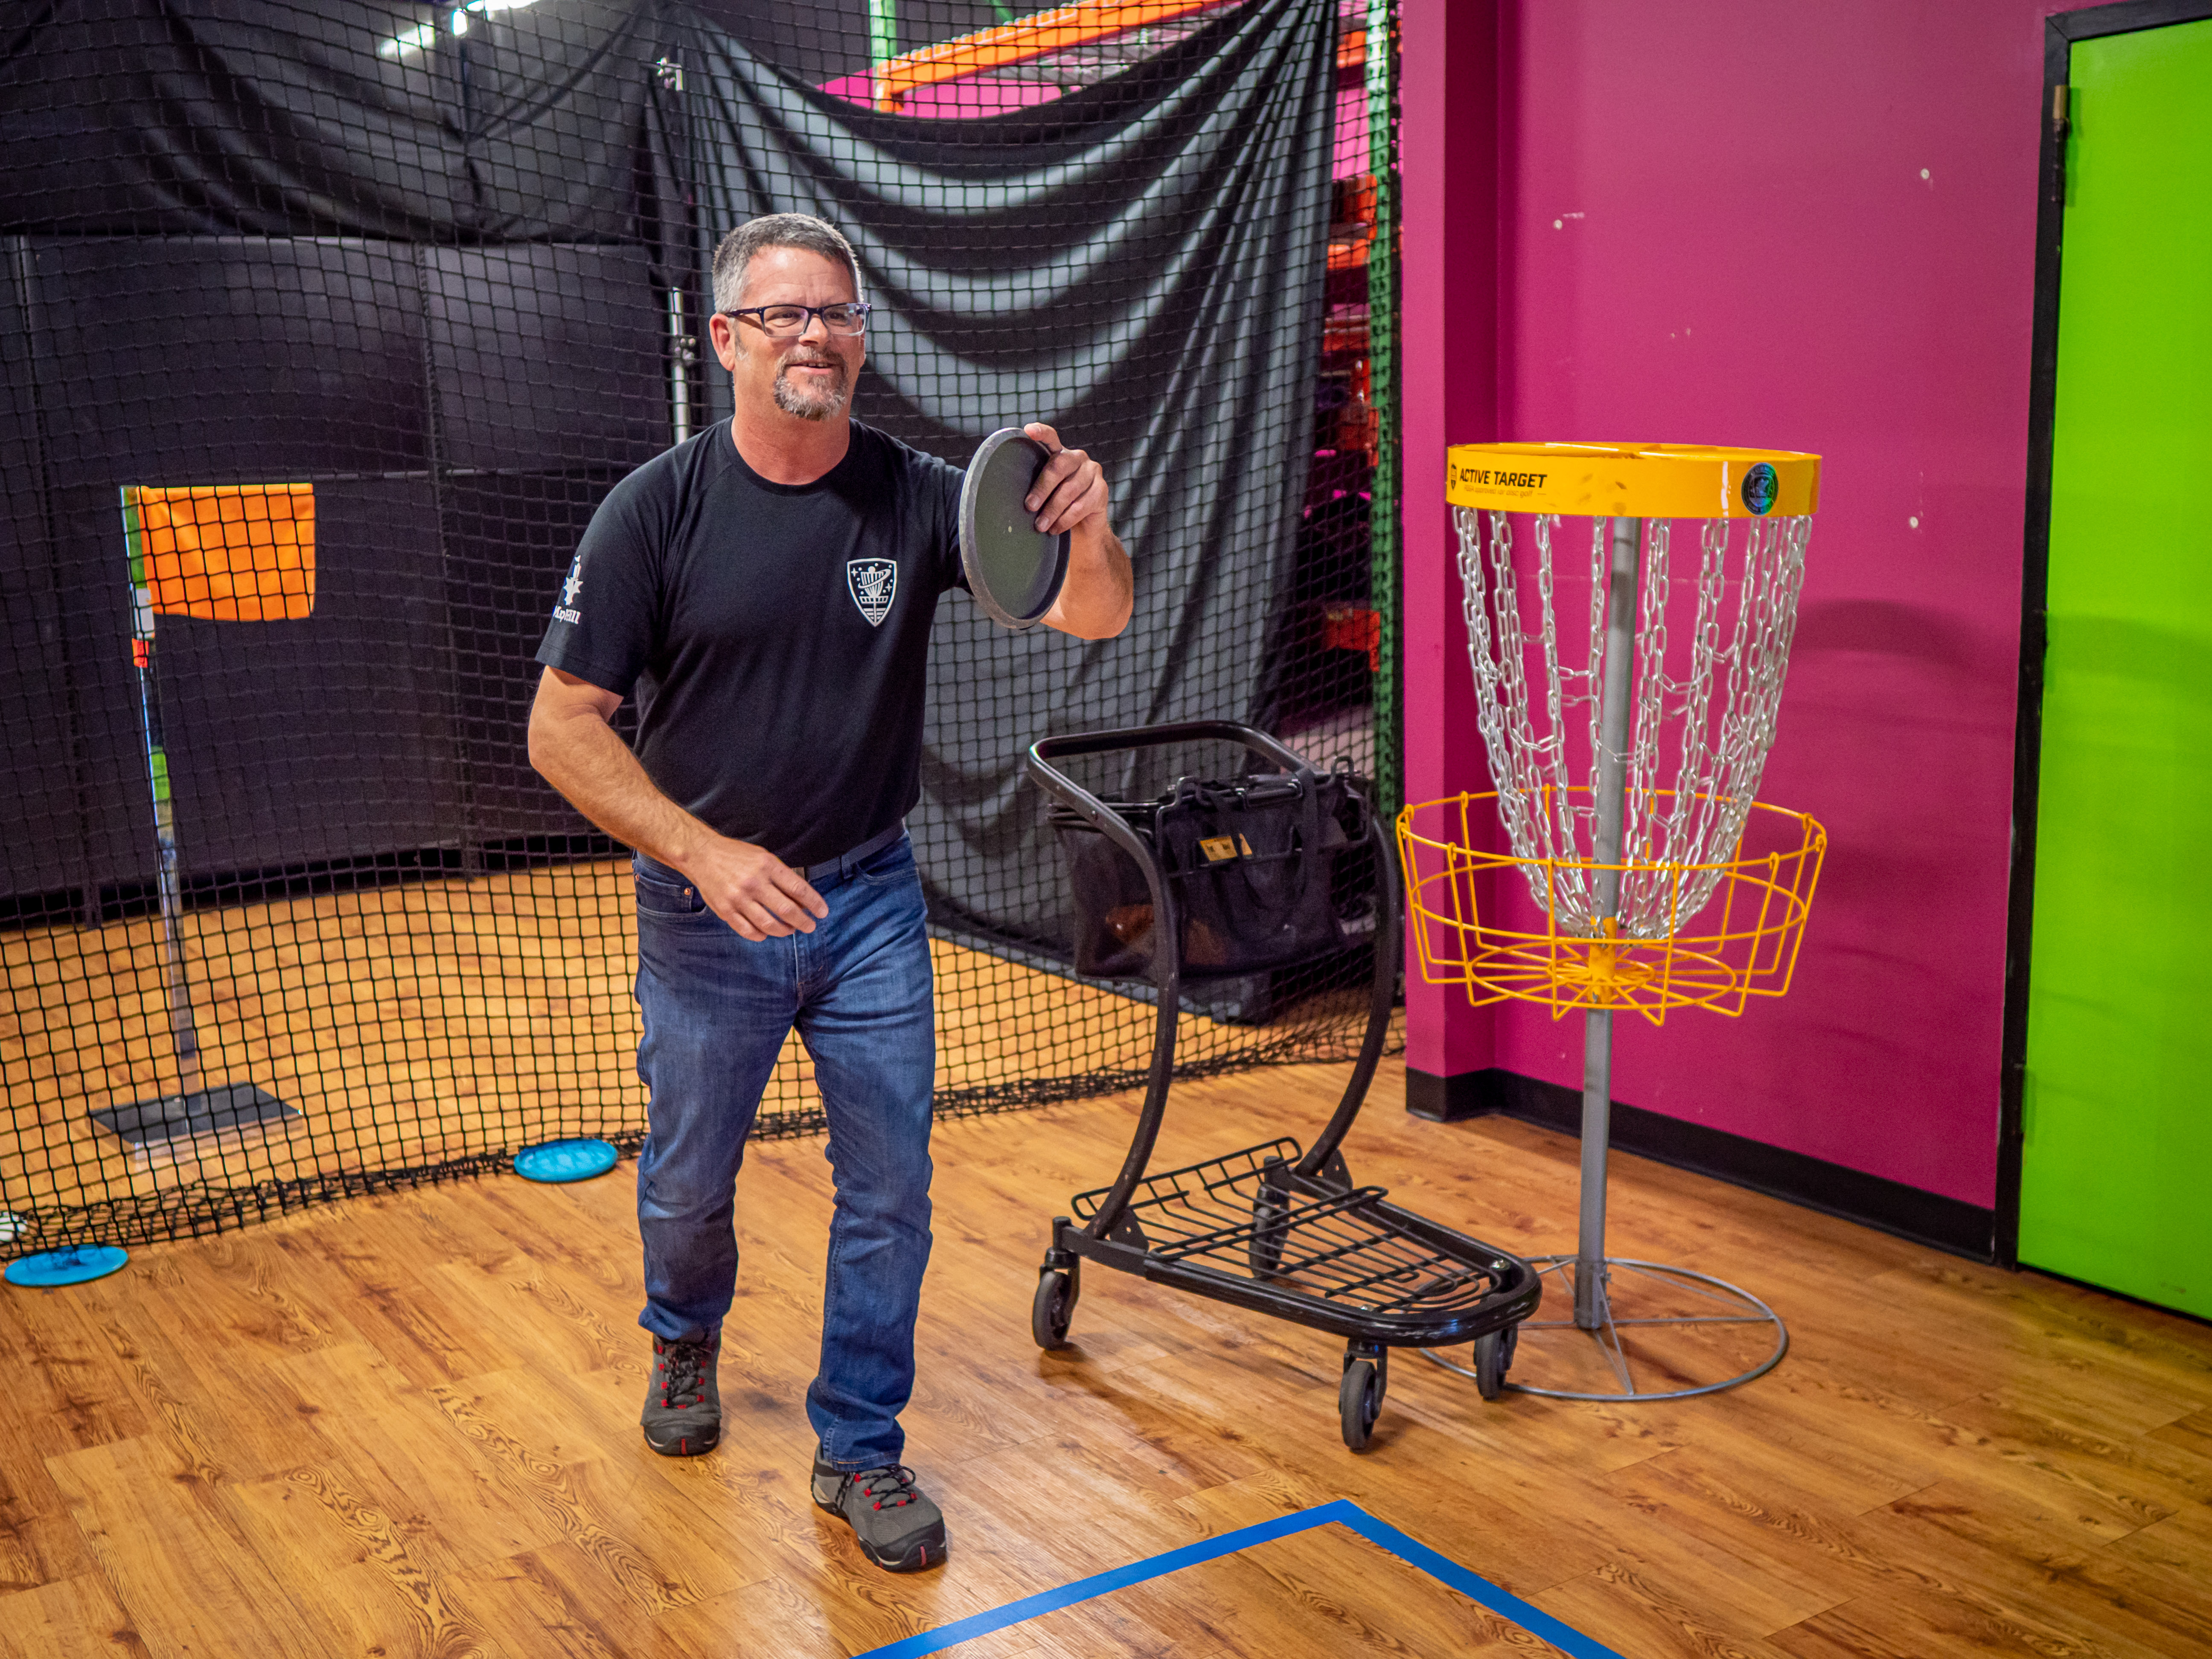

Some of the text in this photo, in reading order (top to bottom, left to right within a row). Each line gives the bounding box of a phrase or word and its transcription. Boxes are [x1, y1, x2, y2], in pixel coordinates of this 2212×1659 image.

[1459, 468, 1548, 488] ACTIVE TARGET
[1506, 489, 1519, 497] disc
[1520, 489, 1534, 498] golf
